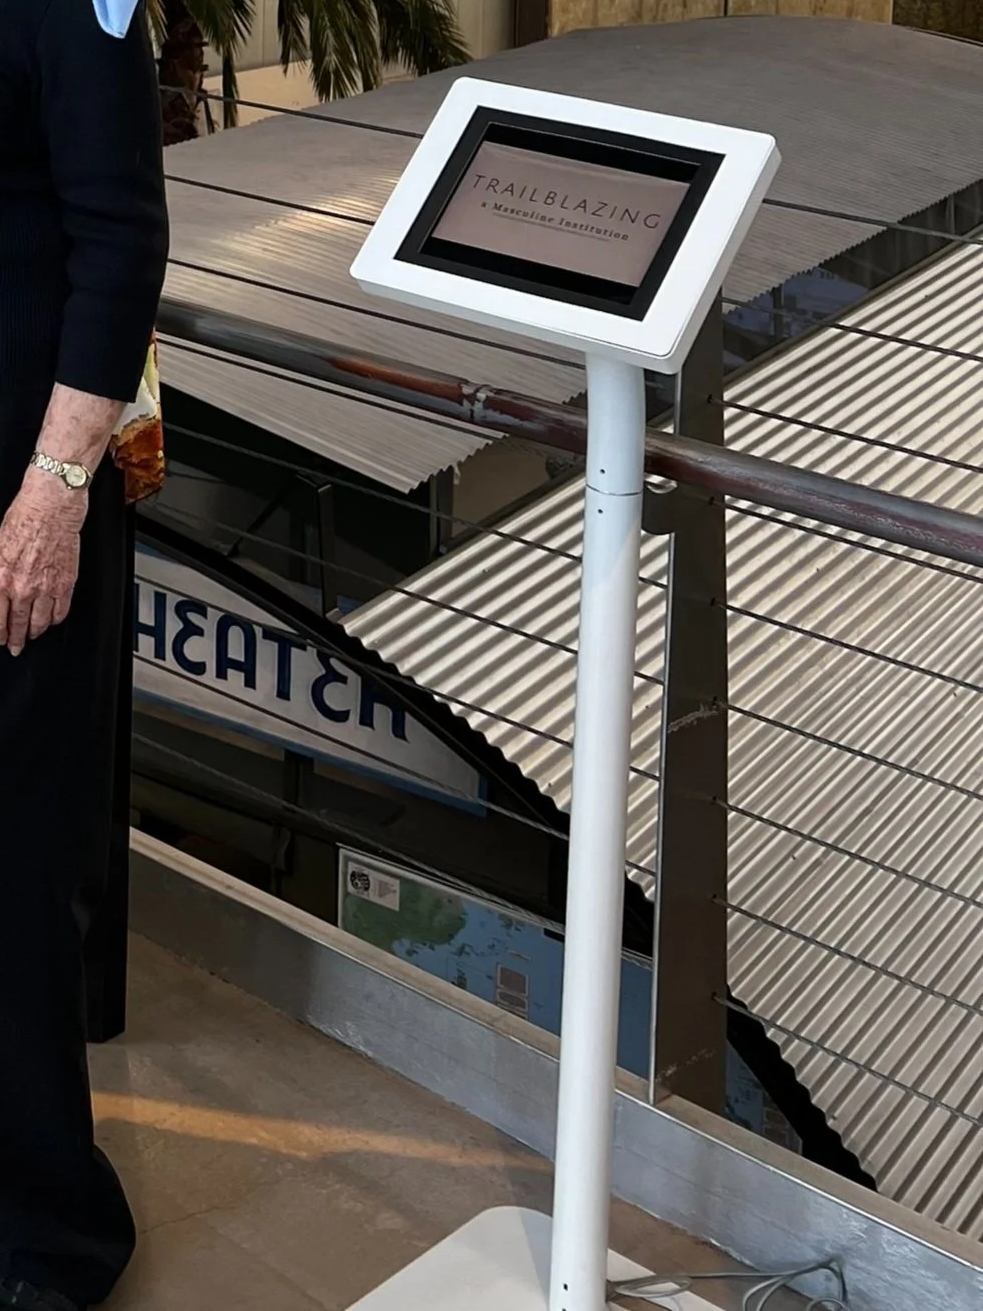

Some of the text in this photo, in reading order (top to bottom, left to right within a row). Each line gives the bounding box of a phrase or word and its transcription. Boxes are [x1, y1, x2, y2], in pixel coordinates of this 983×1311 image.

[472, 174, 662, 230] TRAILBLAZING
[492, 202, 556, 224] Masculine
[559, 217, 630, 242] Institution
